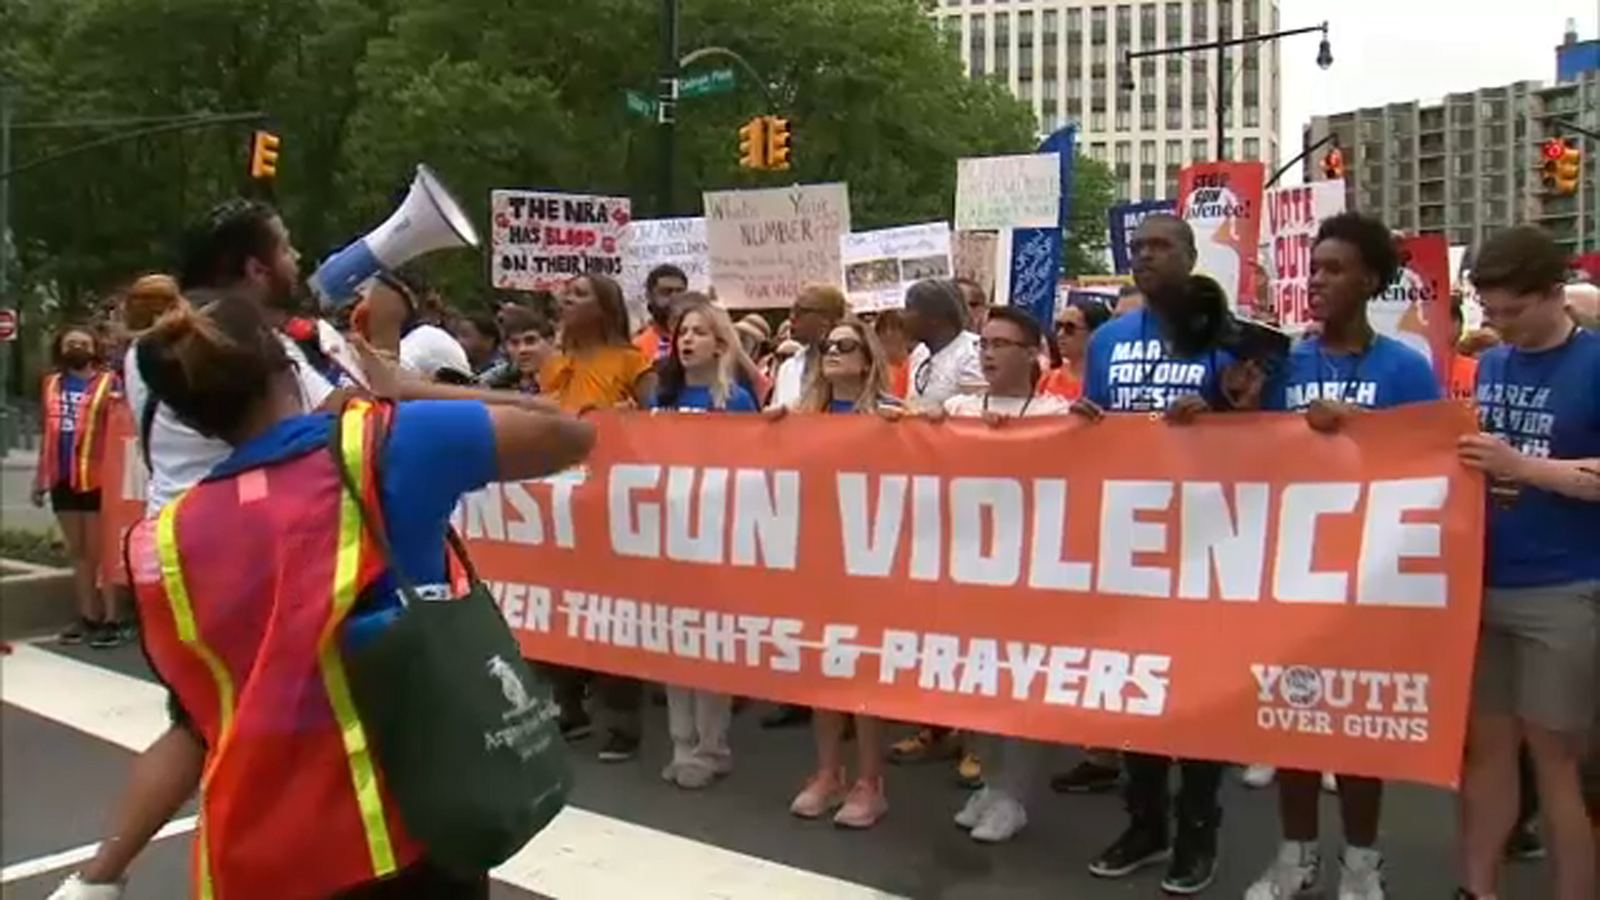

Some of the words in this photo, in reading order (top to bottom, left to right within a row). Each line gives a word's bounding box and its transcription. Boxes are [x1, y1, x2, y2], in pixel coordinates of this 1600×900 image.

[509, 197, 559, 221] THE
[564, 201, 609, 224] NRA
[1267, 187, 1314, 234] VOTE
[509, 225, 541, 244] HAS
[544, 227, 596, 247] BLOOD
[502, 254, 527, 271] ON
[533, 256, 580, 274] THEIR
[1110, 339, 1168, 362] MAR
[1152, 362, 1206, 385] OUR
[1286, 381, 1377, 409] MARCH
[609, 463, 800, 570] GUN
[836, 470, 1449, 608] VIOLENCE
[562, 590, 804, 672] THOUGHTS
[821, 624, 859, 678] &
[879, 629, 1172, 716] PRAYERS
[1251, 663, 1429, 713] YOUTH
[1257, 706, 1333, 735] OVER
[1344, 714, 1429, 742] GUNS
